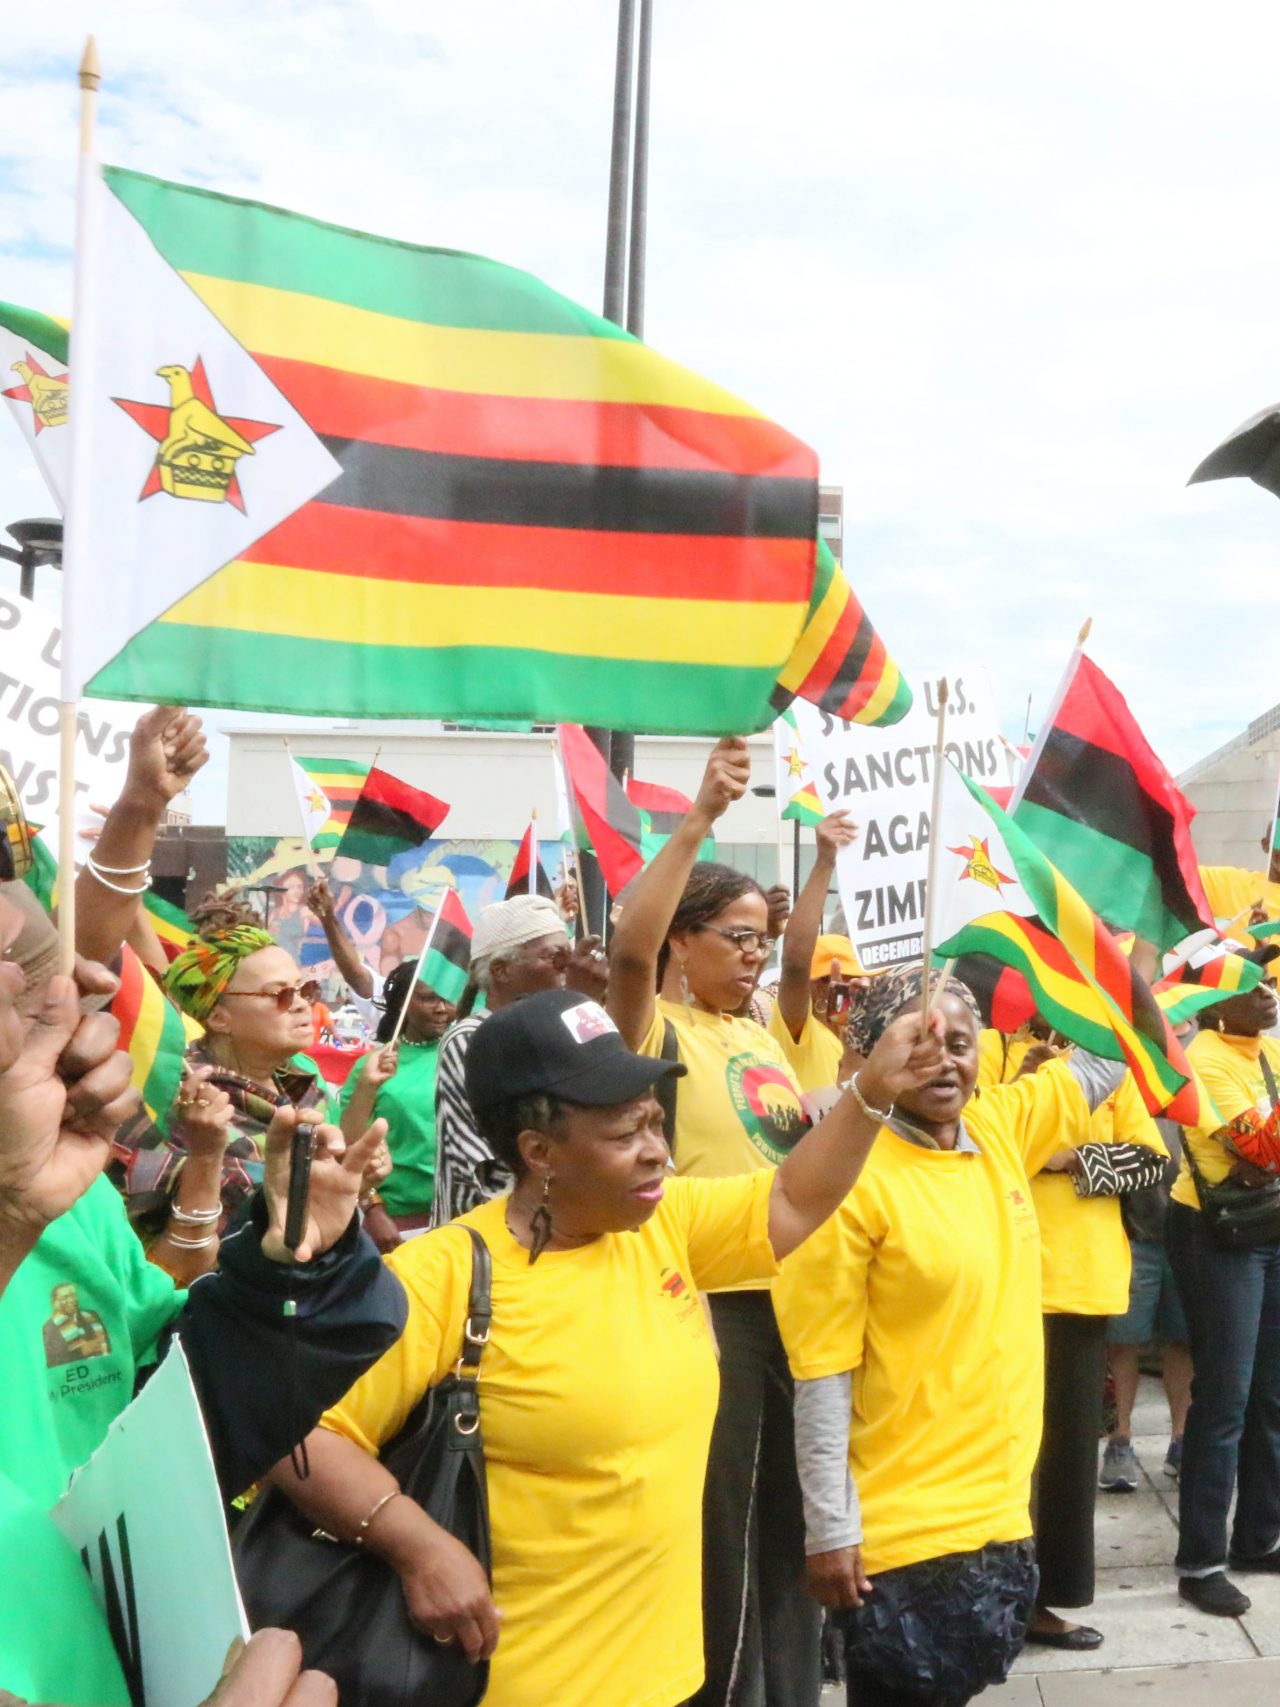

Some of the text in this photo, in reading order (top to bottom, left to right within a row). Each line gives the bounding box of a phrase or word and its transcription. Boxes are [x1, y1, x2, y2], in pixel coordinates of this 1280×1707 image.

[923, 677, 976, 718] U.S.
[823, 738, 998, 802] SANCTONS
[861, 935, 925, 966] DECEMB
[60, 1370, 123, 1398] President
[65, 1365, 89, 1383] ED
